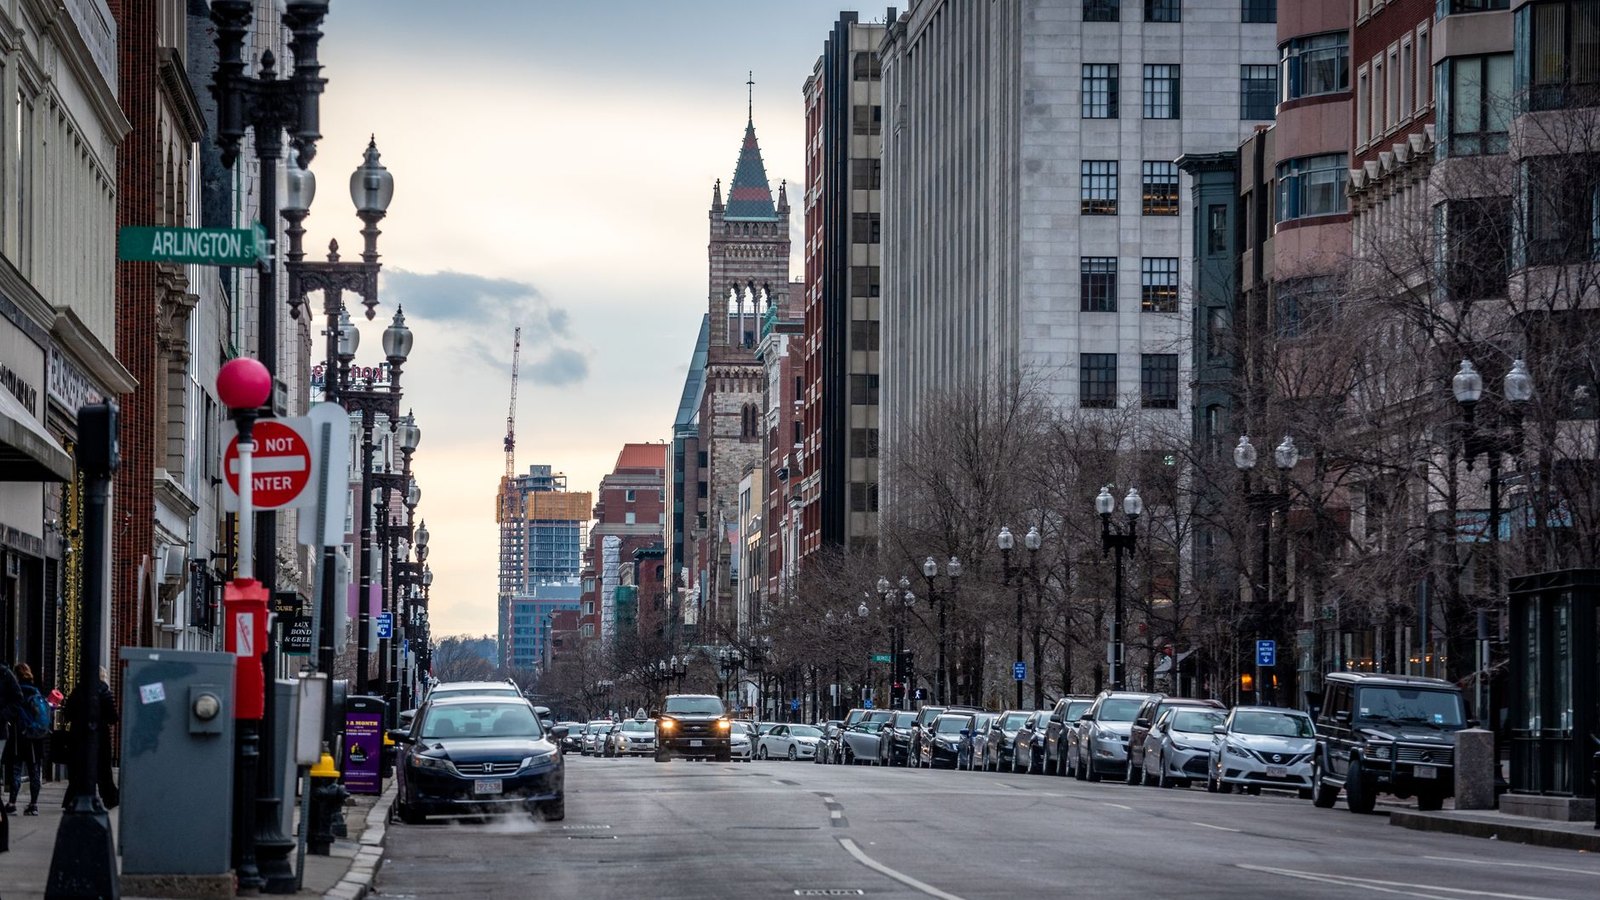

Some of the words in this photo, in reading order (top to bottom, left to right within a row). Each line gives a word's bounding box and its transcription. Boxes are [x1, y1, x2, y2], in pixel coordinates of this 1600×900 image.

[151, 231, 241, 258] ARLINGTON
[265, 438, 294, 452] NOT
[252, 476, 292, 491] NTER
